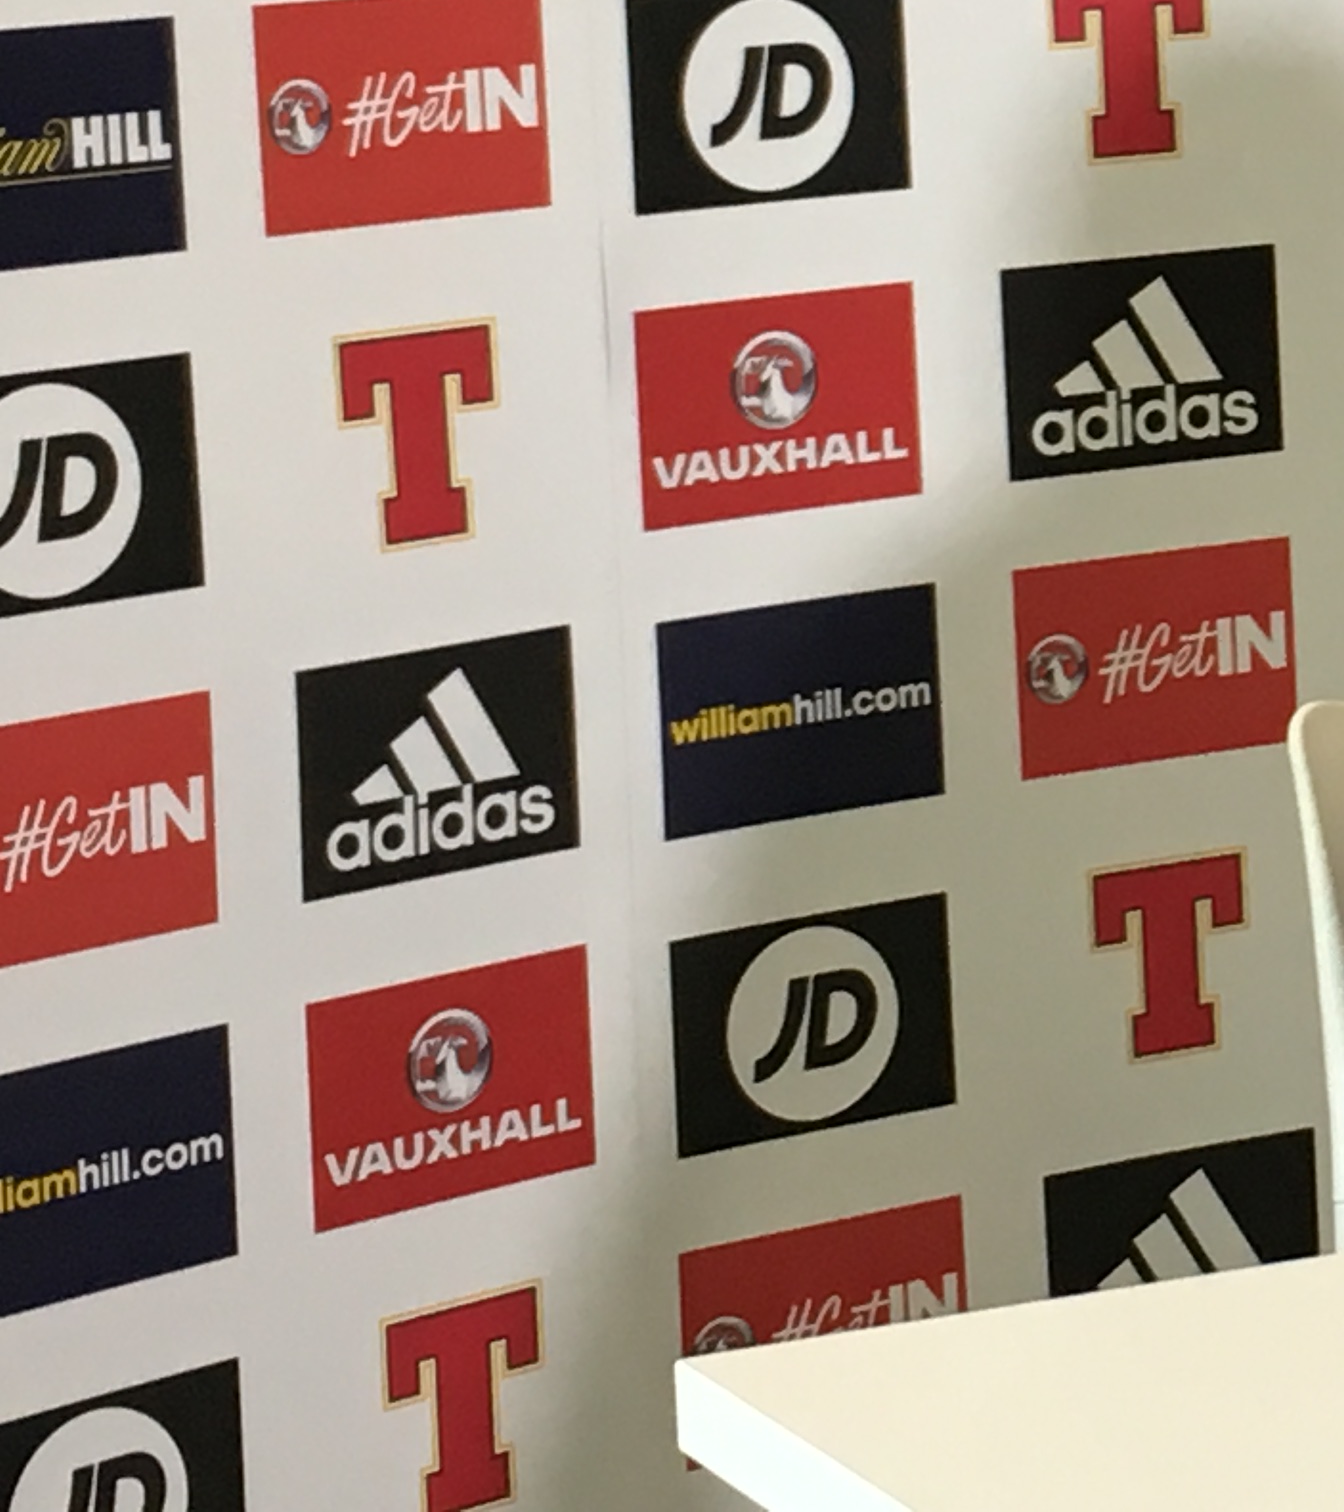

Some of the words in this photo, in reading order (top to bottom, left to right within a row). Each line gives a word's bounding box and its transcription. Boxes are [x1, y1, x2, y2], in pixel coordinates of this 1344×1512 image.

[72, 110, 172, 169] HILL
[343, 64, 539, 157] #GetIN
[710, 42, 832, 149] JD
[333, 316, 500, 553] T
[653, 430, 909, 489] VAUXHALL
[1032, 385, 1258, 457] adidas
[0, 432, 118, 548] JD
[1099, 610, 1286, 703] #GetIN
[670, 683, 930, 746] williamhill.com
[0, 775, 205, 888] #GetIN
[327, 782, 555, 871] adidas
[1087, 846, 1246, 1064] T
[754, 969, 878, 1083] JD
[0, 1131, 224, 1213] liamhill.com
[324, 1097, 582, 1187] VAUXHALL
[380, 1279, 544, 1512] T
